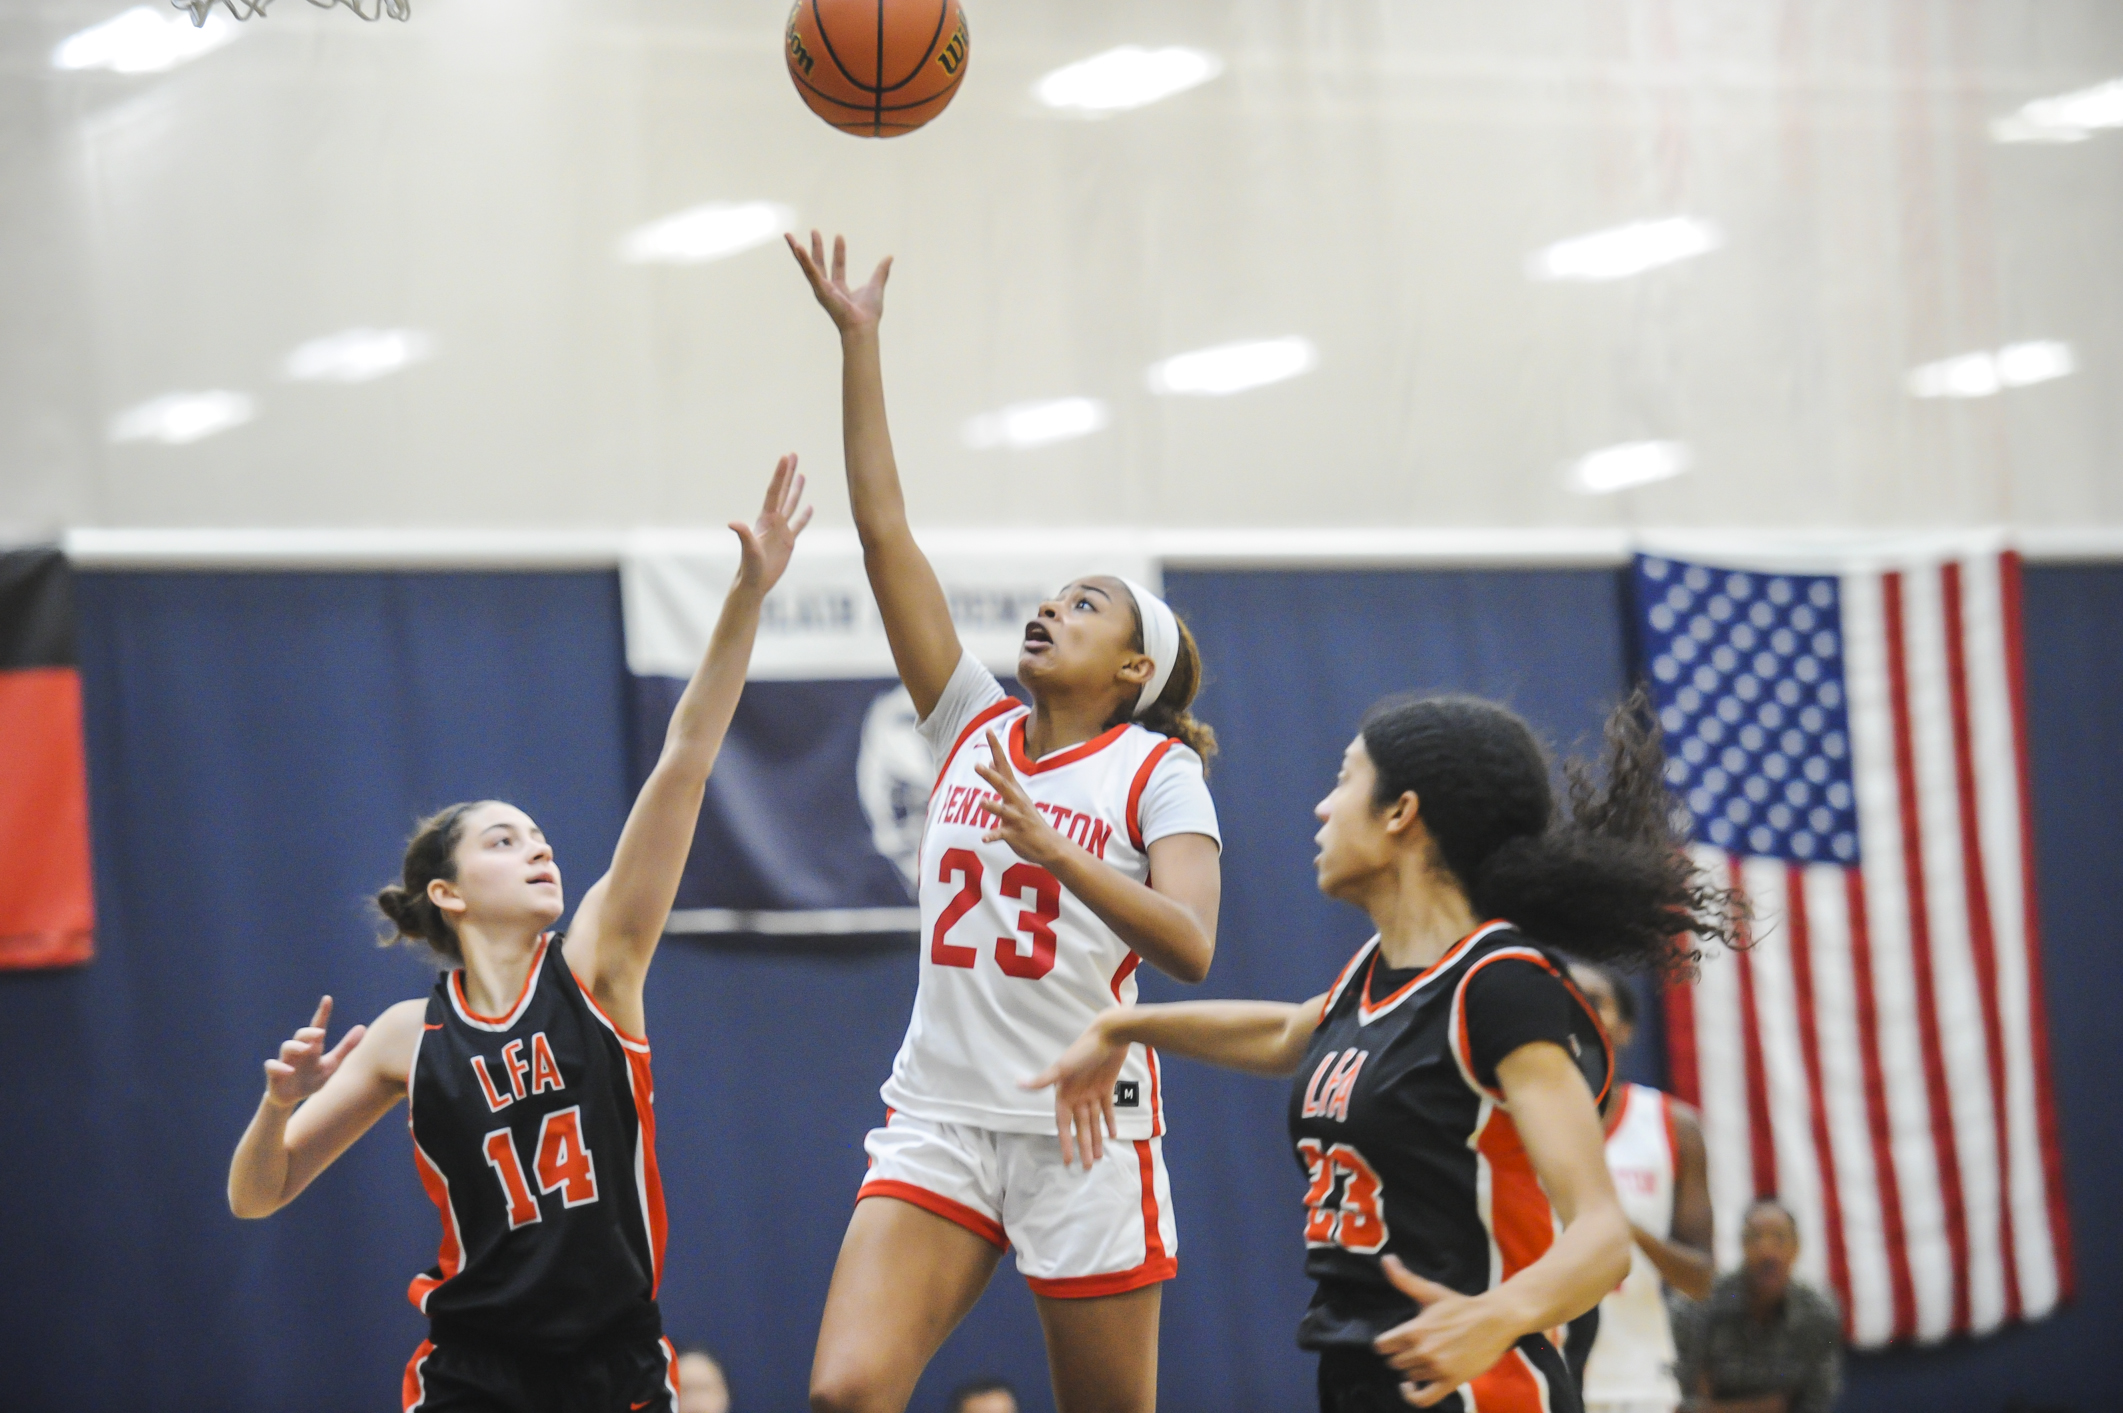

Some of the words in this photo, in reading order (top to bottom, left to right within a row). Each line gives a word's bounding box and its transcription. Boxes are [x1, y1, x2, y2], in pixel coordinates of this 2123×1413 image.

[931, 847, 1062, 981] 23
[470, 1031, 566, 1113] LFA
[1124, 1088, 1134, 1100] M
[1302, 1046, 1369, 1123] LFA
[482, 1104, 599, 1231] 14
[1297, 1137, 1390, 1255] 23
